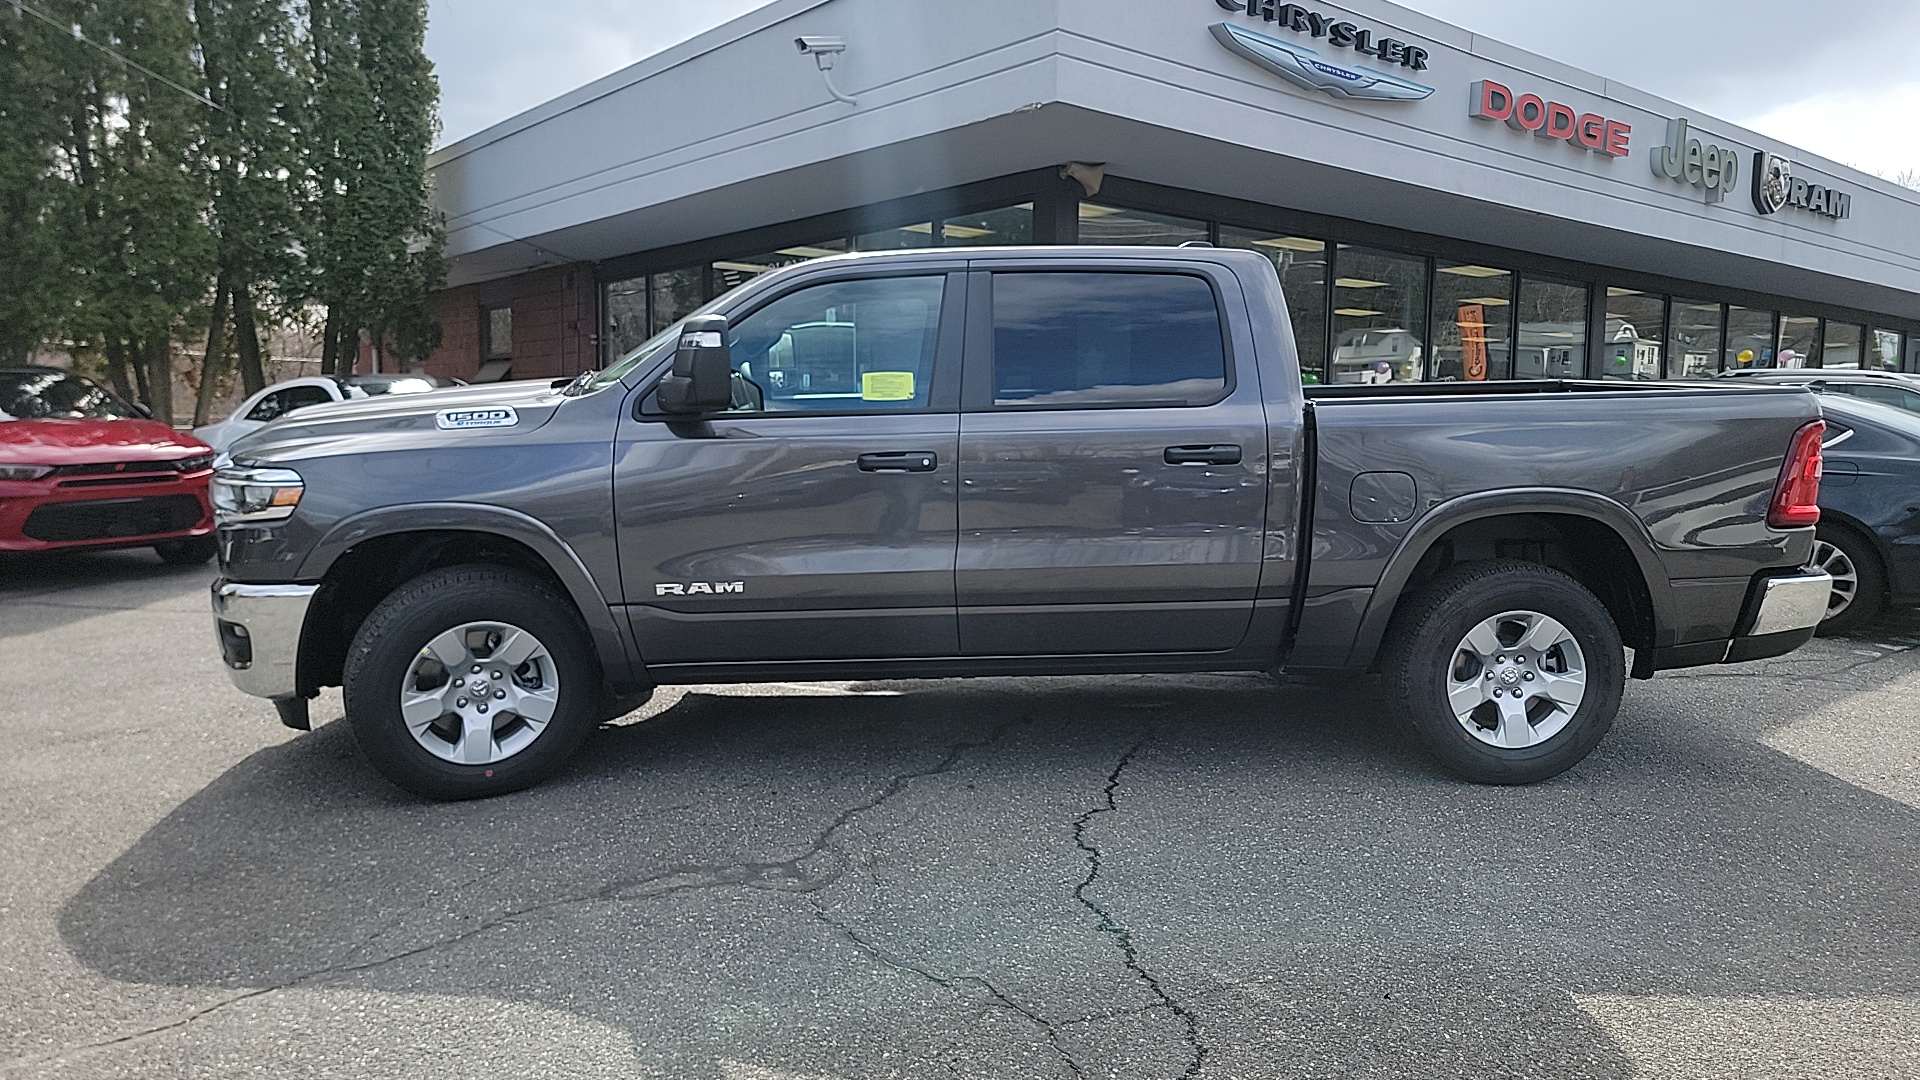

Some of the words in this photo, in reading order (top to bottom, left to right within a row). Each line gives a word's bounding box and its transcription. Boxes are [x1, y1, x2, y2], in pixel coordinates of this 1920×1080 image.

[1314, 63, 1356, 79] CHRYSLER
[1472, 79, 1632, 158] DODGE
[1653, 118, 1738, 203] Jeep
[1789, 177, 1851, 219] RAM
[448, 411, 506, 422] 1500
[655, 581, 744, 596] RAM
